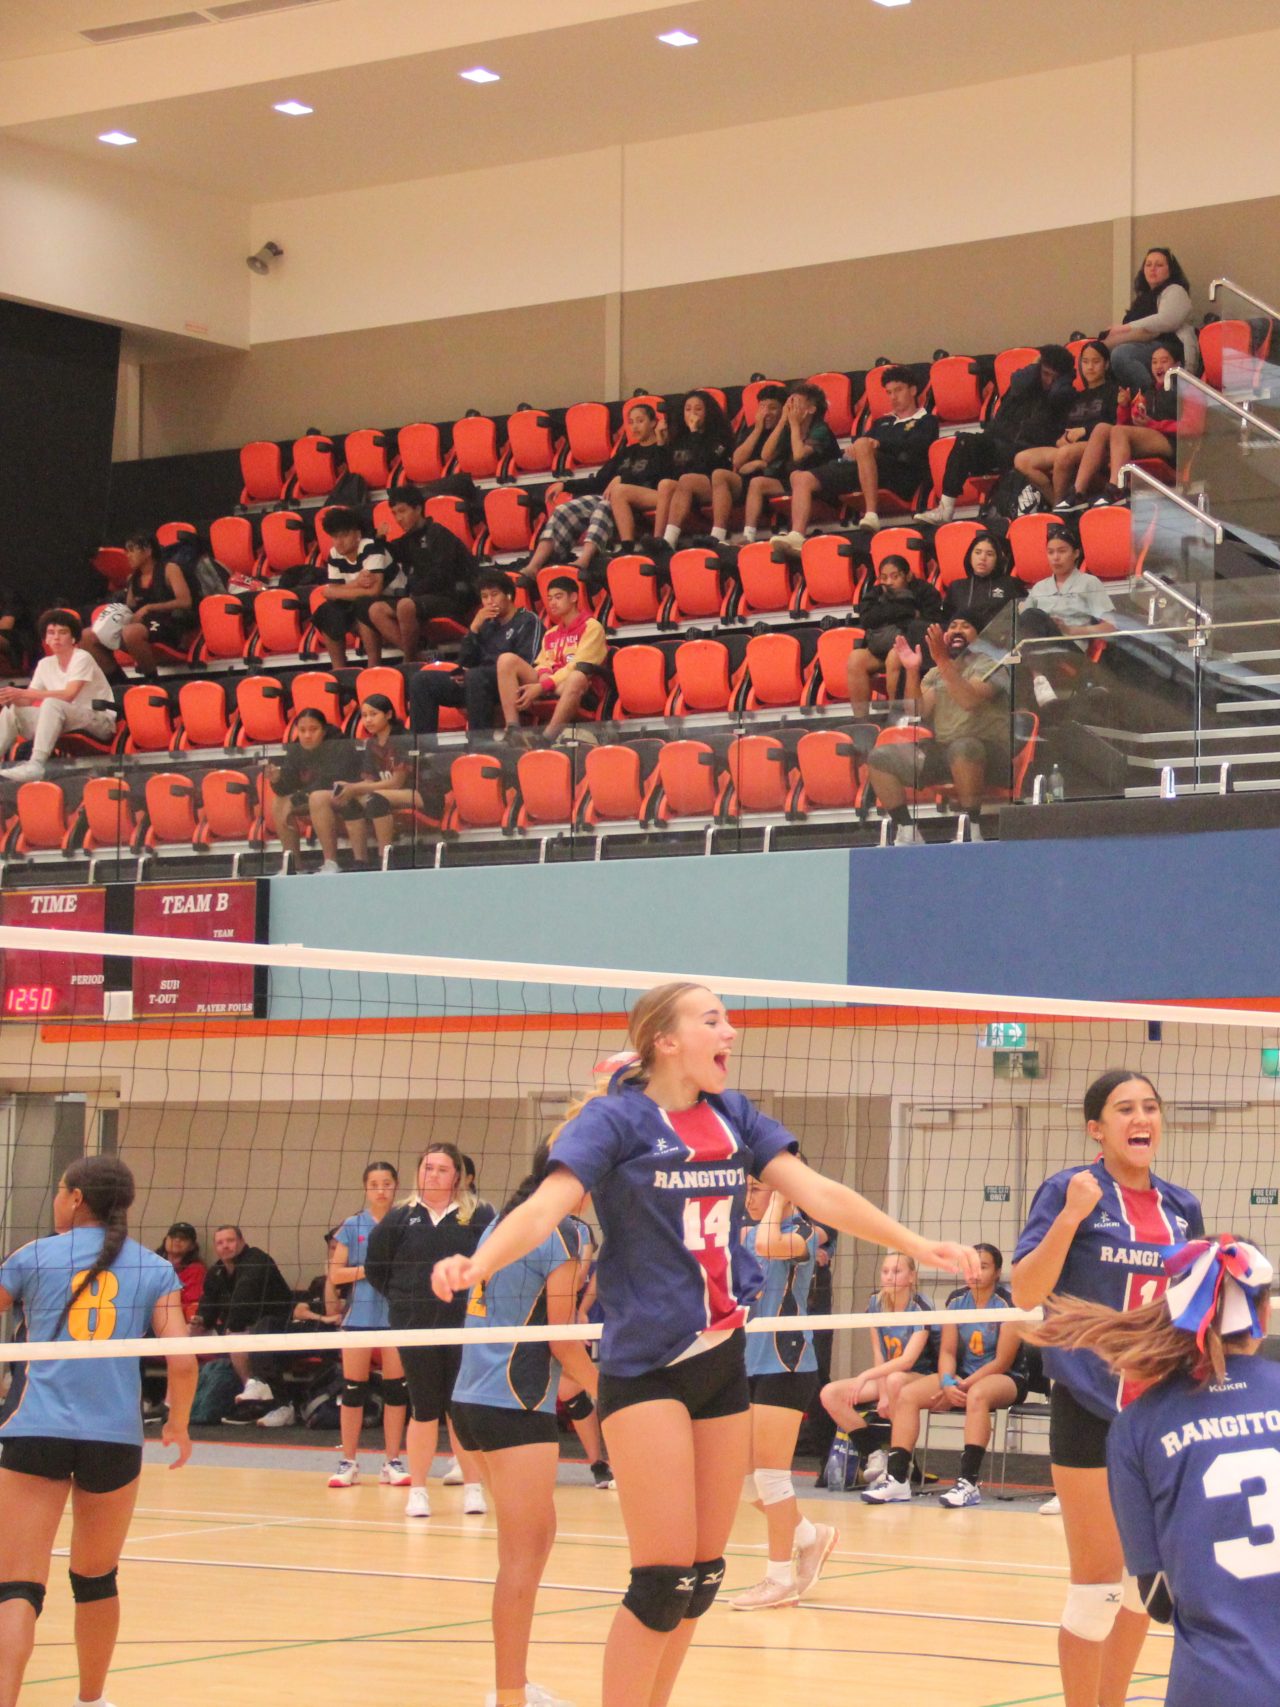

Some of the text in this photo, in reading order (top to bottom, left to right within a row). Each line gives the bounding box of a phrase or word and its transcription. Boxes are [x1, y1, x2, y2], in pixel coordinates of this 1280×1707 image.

[31, 894, 77, 914] TIME
[162, 892, 229, 914] TEAM B
[213, 928, 234, 938] TEAM
[71, 974, 104, 985] PERIOD
[160, 979, 180, 990] SUB
[149, 993, 178, 1005] T-OUT
[196, 1003, 253, 1013] PLAYER FOULS
[653, 1167, 746, 1189] RANGITOT
[683, 1198, 733, 1250] 14
[1100, 1246, 1165, 1269] RANGI
[68, 1269, 119, 1341] 8
[969, 1330, 985, 1356] 4
[1209, 1381, 1247, 1393] KUKRI
